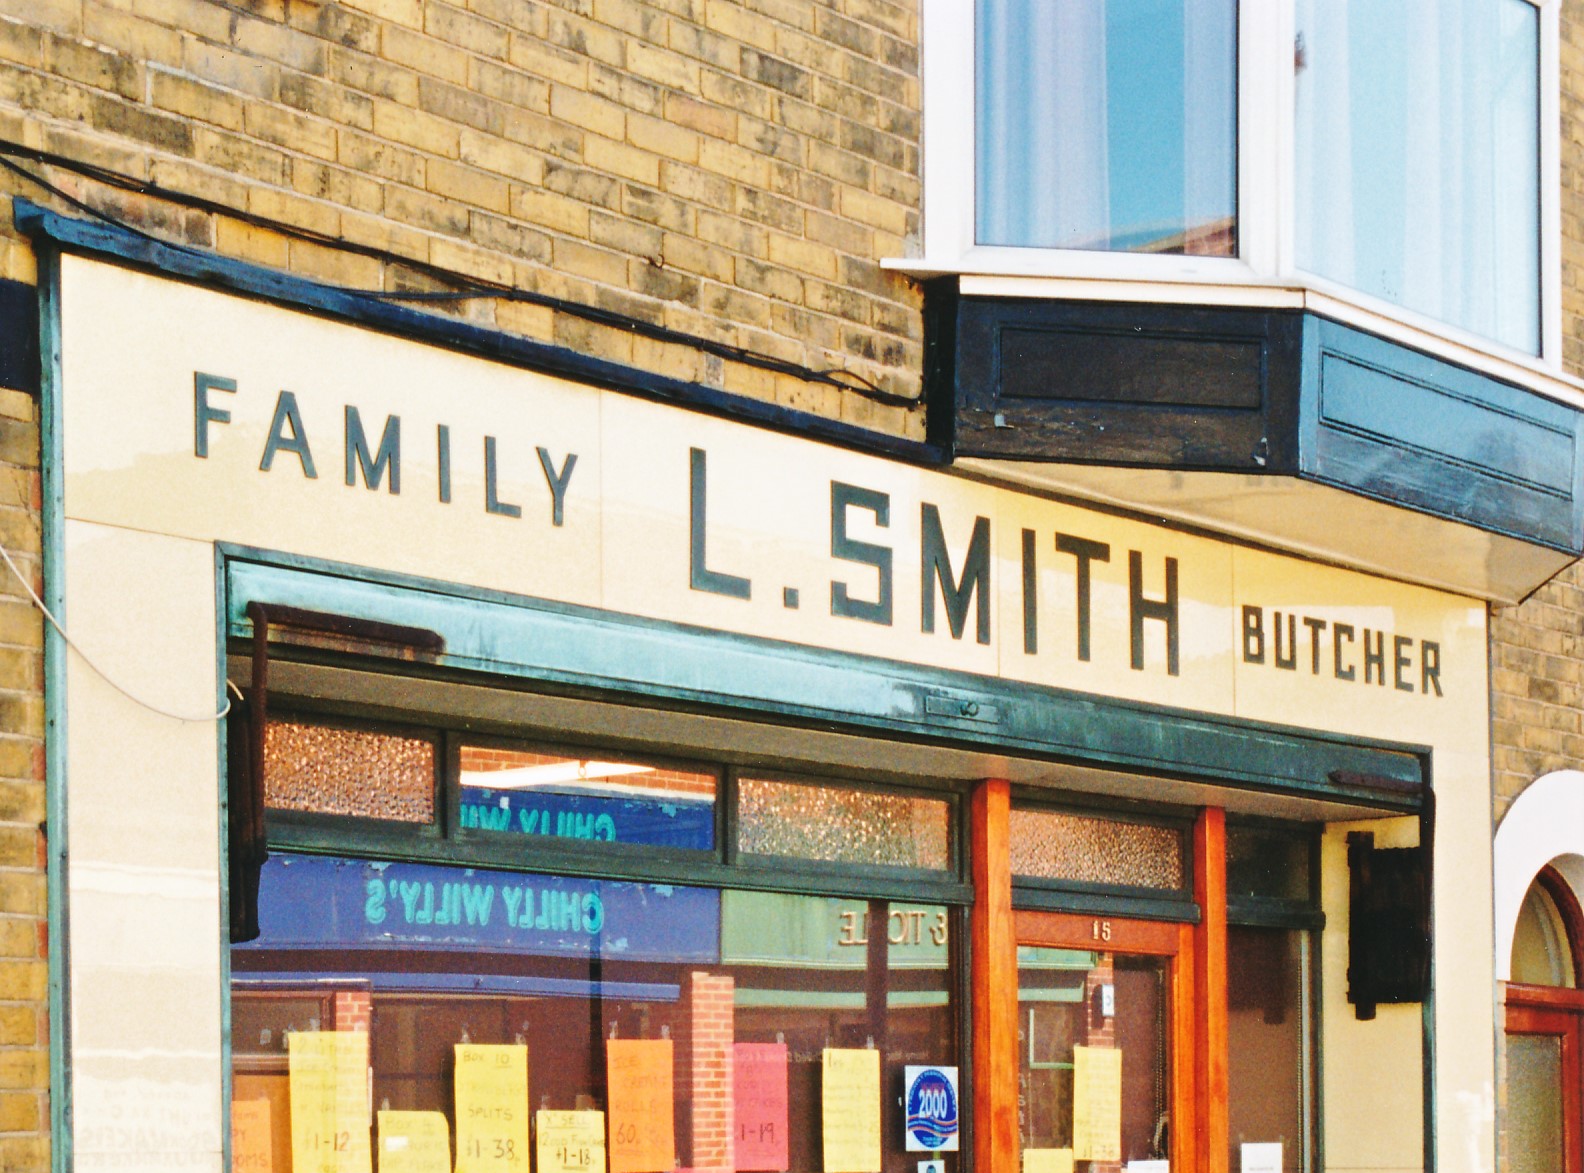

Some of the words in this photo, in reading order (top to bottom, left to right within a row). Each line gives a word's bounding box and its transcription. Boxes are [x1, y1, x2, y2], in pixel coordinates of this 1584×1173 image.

[193, 371, 578, 527] FAMILY
[1243, 605, 1443, 697] BUTCHER
[1093, 919, 1111, 942] 15
[918, 1088, 948, 1119] 2000
